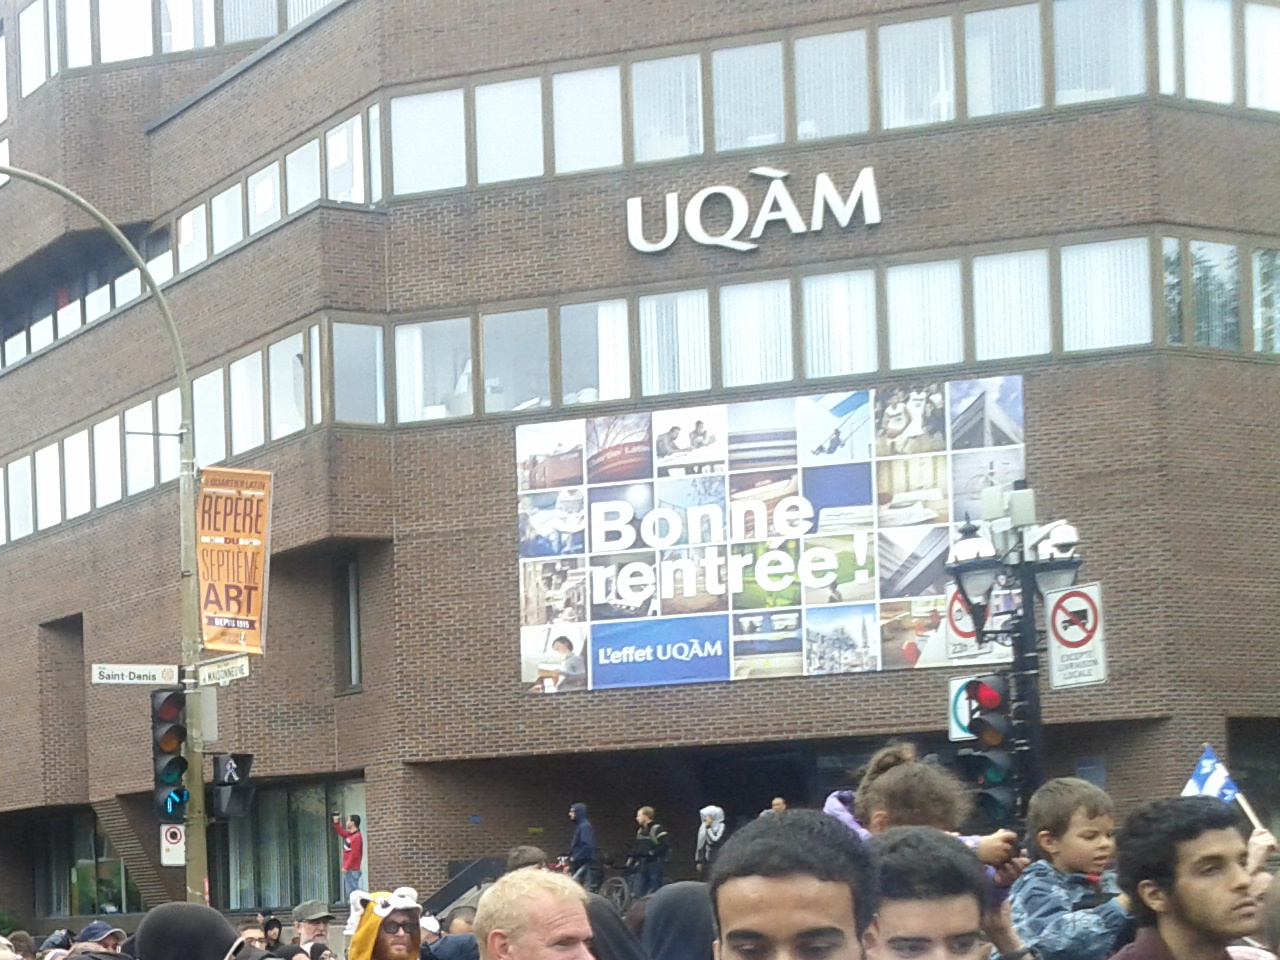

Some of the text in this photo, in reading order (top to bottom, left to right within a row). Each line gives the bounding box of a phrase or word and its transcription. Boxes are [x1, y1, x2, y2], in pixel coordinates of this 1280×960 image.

[626, 166, 882, 252] UQÀM
[590, 496, 815, 551] Bonne
[204, 583, 258, 615] ART
[598, 639, 722, 664] L'effet UQÀM
